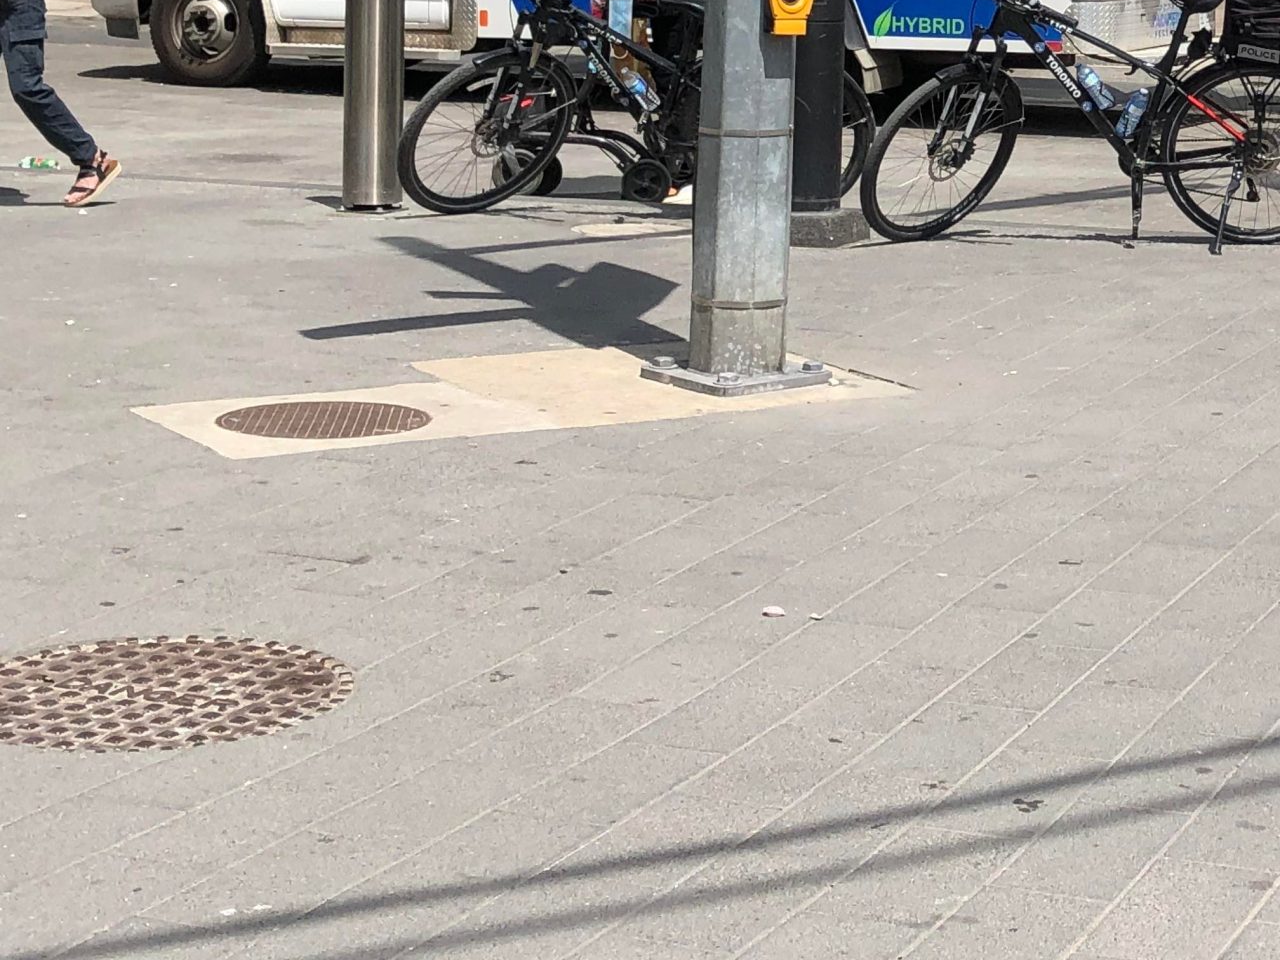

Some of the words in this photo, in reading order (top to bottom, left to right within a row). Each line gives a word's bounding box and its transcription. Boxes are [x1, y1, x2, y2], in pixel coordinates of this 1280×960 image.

[892, 17, 965, 35] HYBRID
[1240, 46, 1277, 61] POLICE
[1045, 55, 1083, 99] TORONTO
